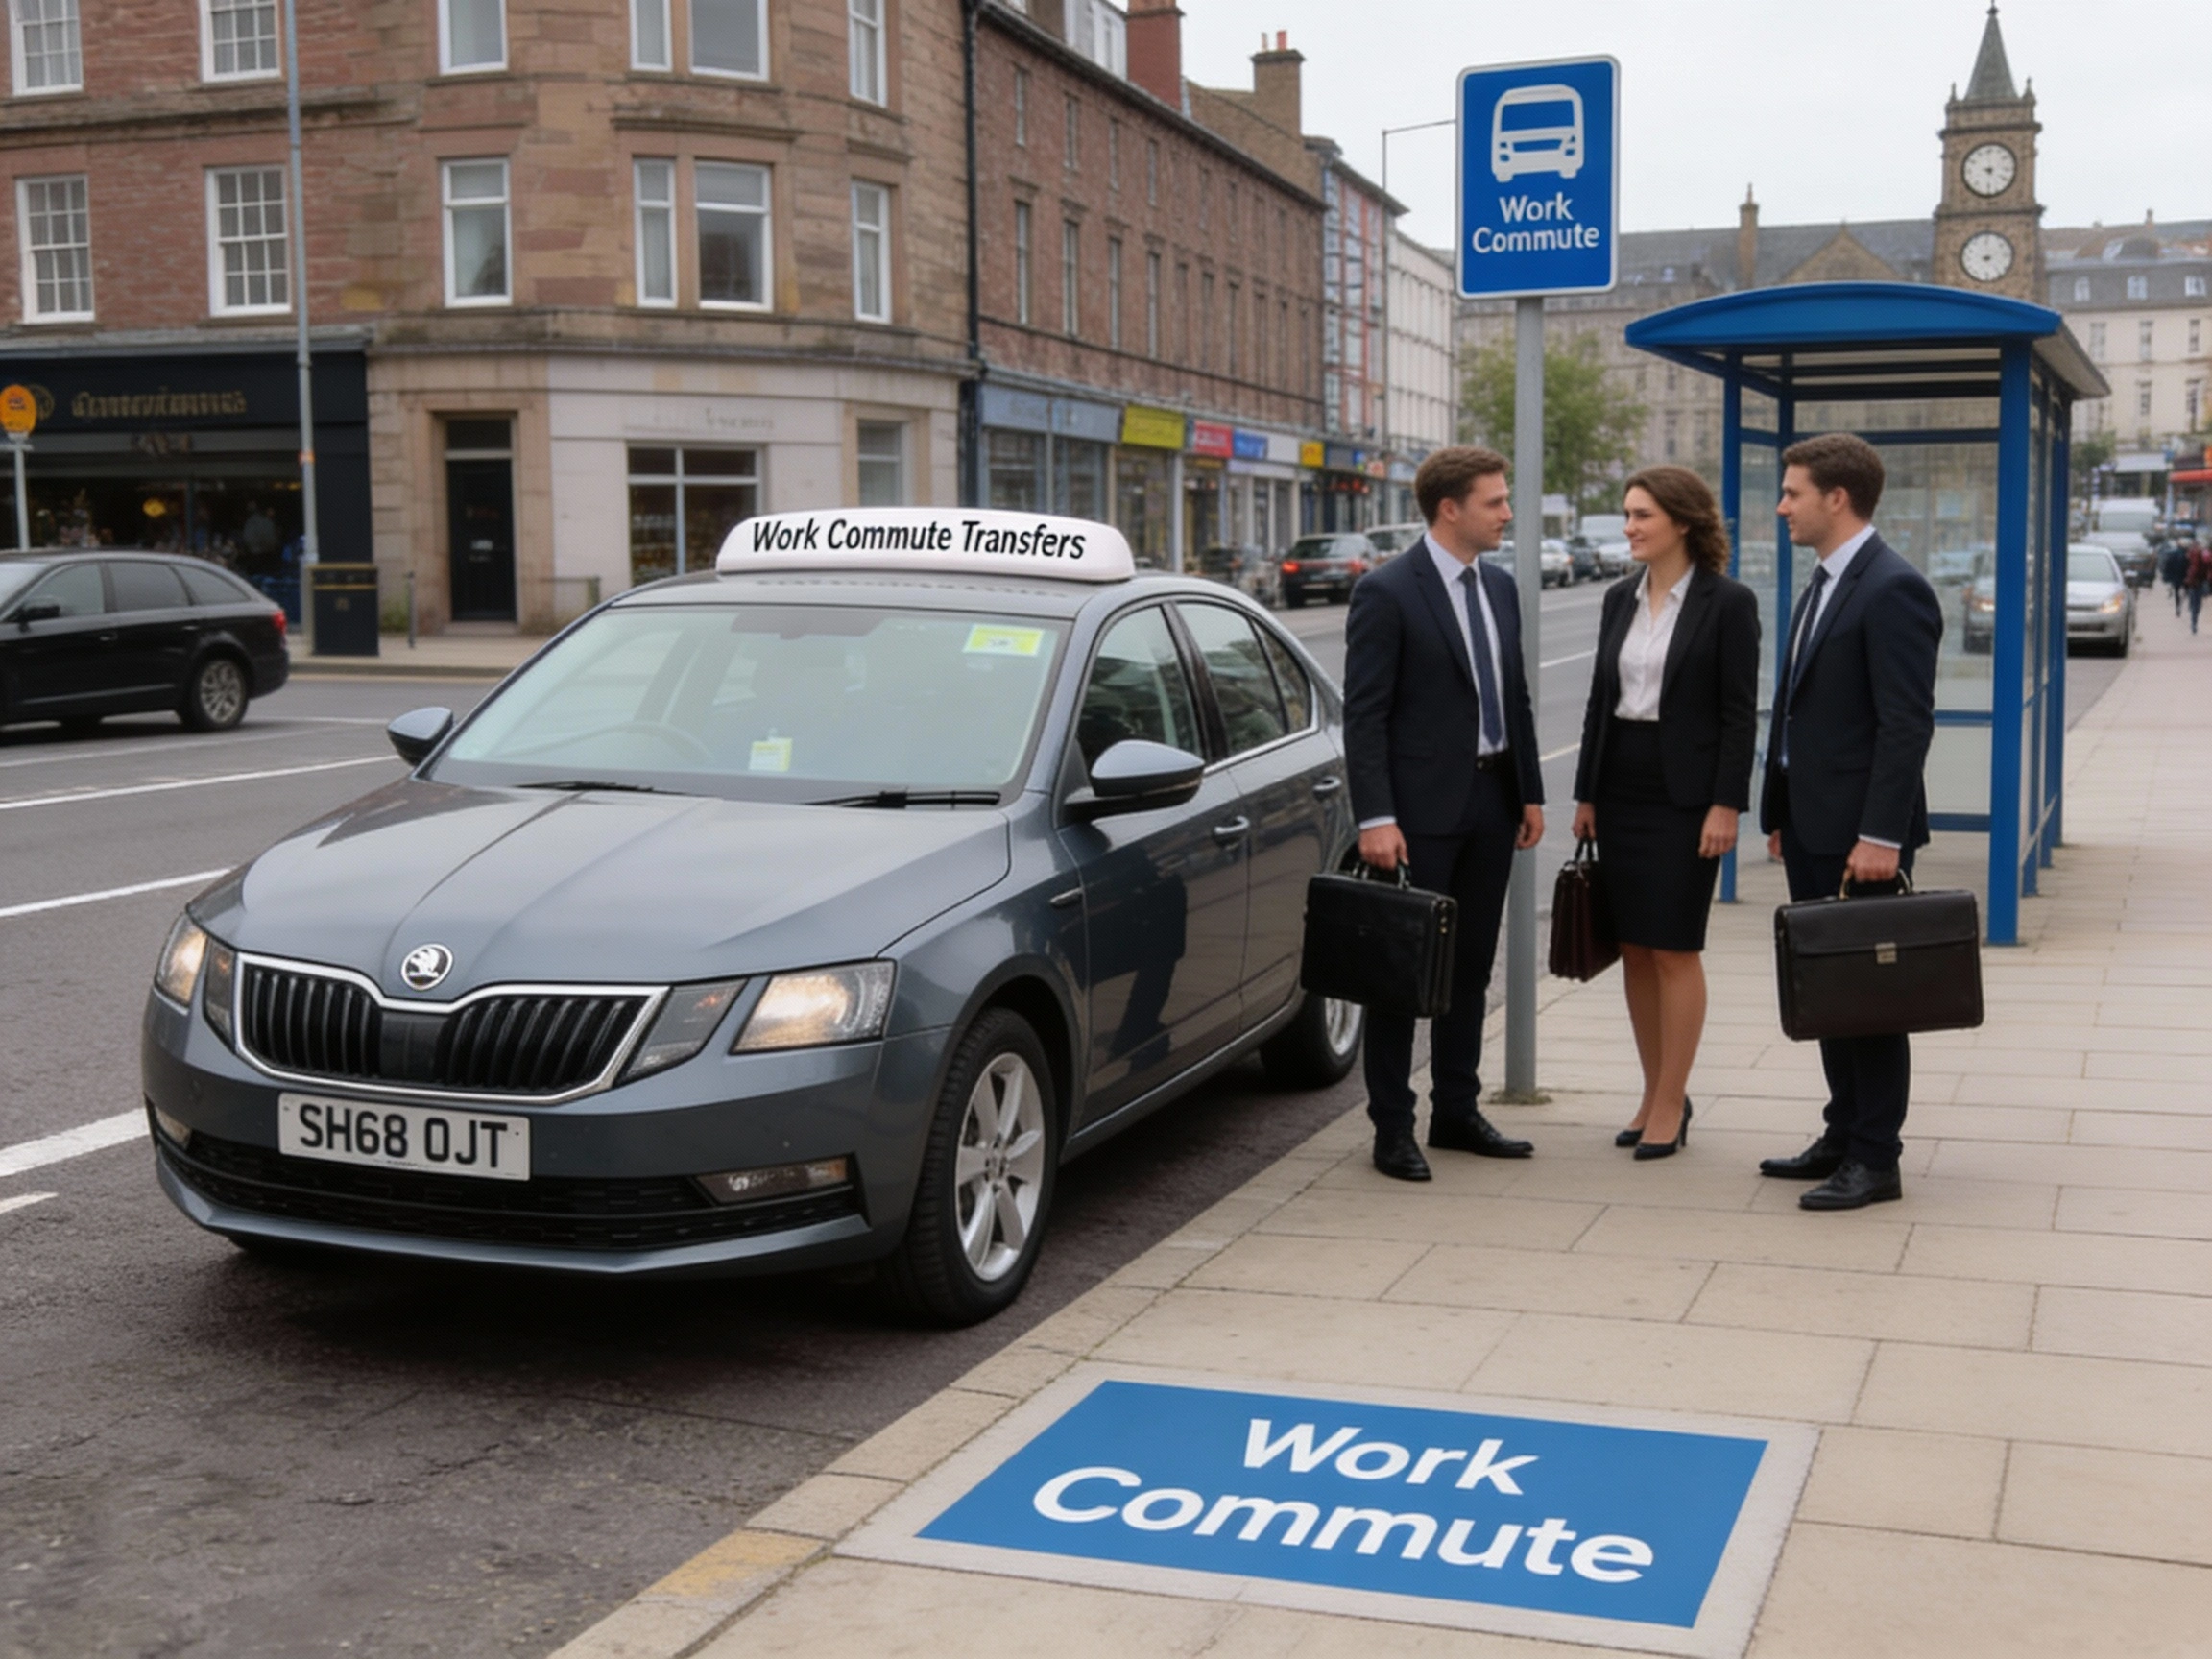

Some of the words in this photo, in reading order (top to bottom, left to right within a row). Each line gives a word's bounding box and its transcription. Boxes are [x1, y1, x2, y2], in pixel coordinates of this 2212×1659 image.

[1499, 191, 1574, 224] Work
[1471, 223, 1600, 253] Commute
[753, 518, 820, 552] Work
[828, 518, 953, 553] Commute
[962, 520, 1088, 560] Transfers
[299, 1102, 409, 1160] SH68
[423, 1116, 509, 1169] OJT
[1243, 1417, 1539, 1497] Work
[1032, 1465, 1655, 1584] Commute
